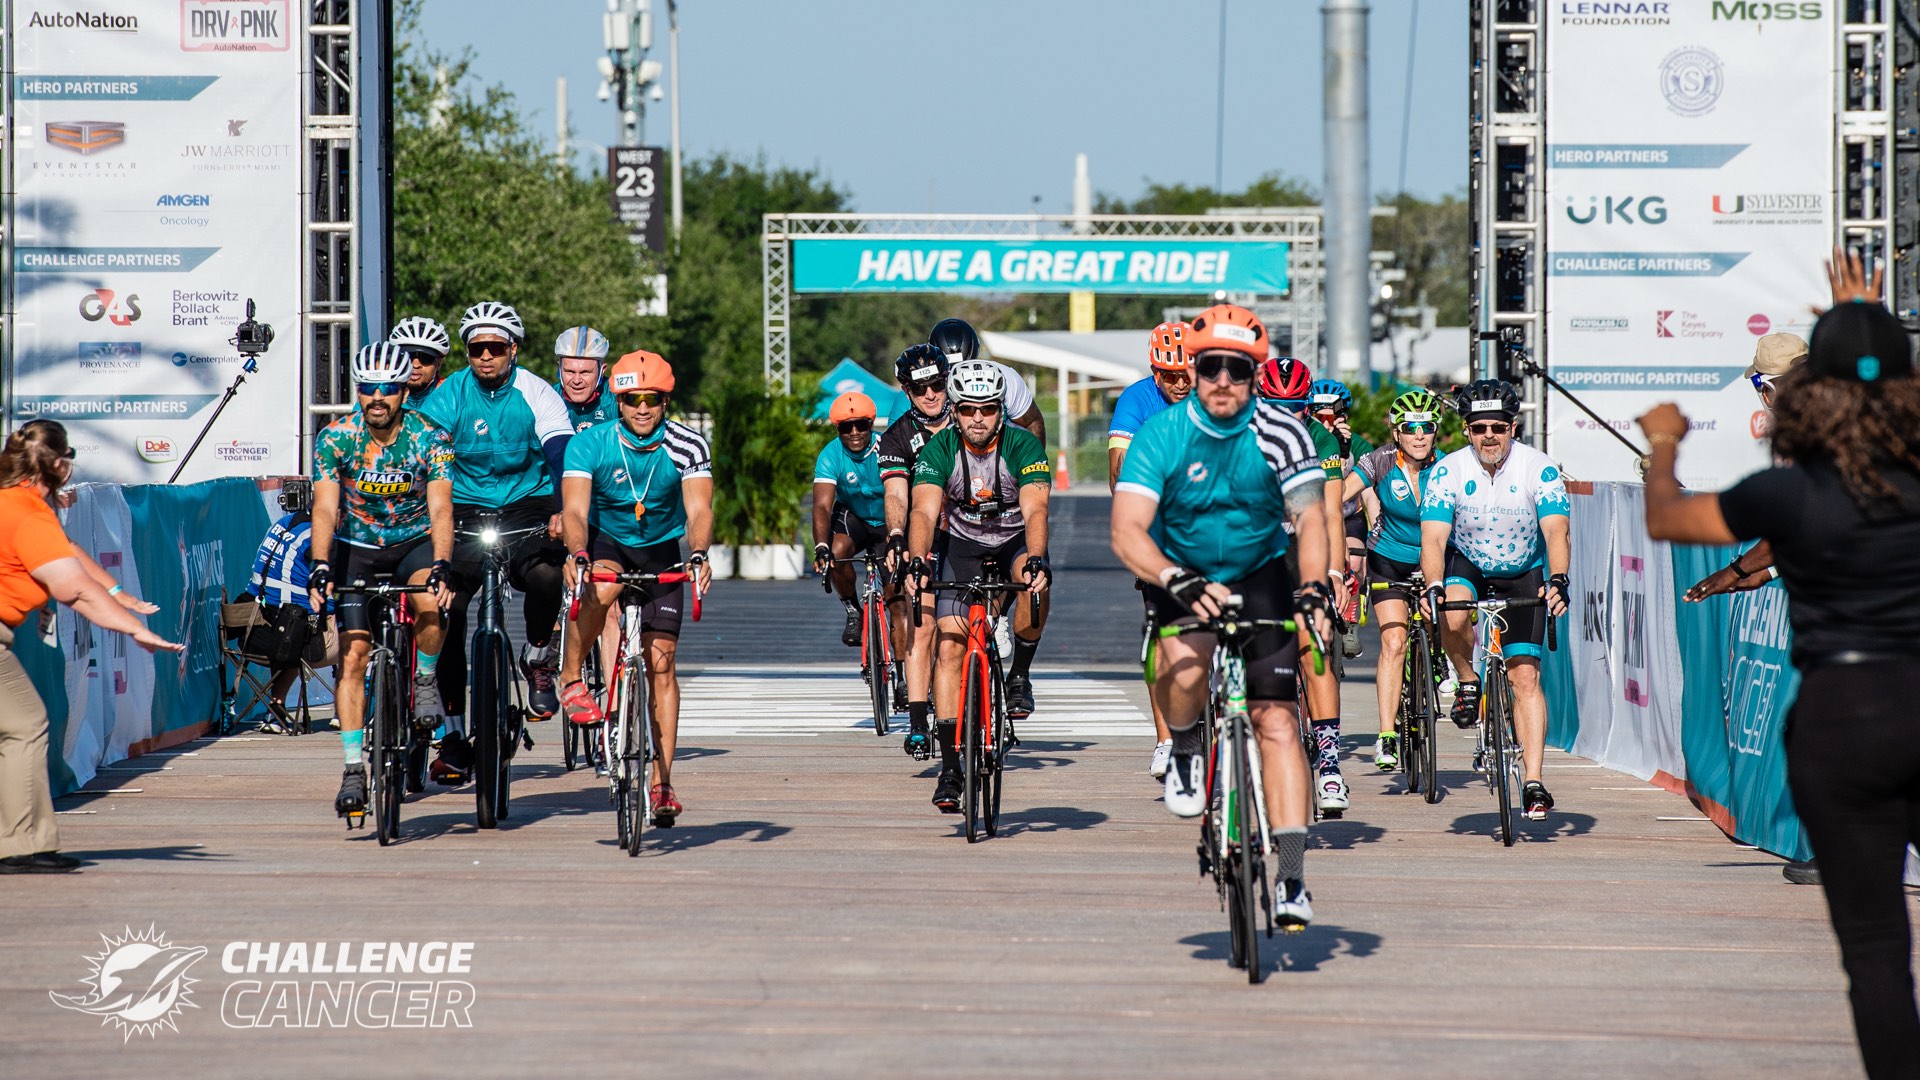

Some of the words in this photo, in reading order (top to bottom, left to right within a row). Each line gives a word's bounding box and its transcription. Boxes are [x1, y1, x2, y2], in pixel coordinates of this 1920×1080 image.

[1562, 2, 1669, 14] LENNAR
[29, 11, 138, 28] AutoNation
[191, 10, 230, 38] DRV
[240, 10, 278, 38] PNK
[1562, 17, 1670, 25] FOUNDATION
[23, 82, 61, 94] HERO
[65, 82, 138, 94] PARTNERS
[181, 145, 207, 157] JW
[210, 145, 291, 157] MARRIOTT
[1555, 150, 1594, 162] HERO
[1596, 150, 1668, 162] PARTNERS
[616, 166, 655, 197] 23
[156, 194, 210, 206] AMGEN
[1746, 194, 1822, 209] SYLVESTER
[160, 216, 209, 226] Oncology
[24, 254, 104, 266] CHALLENGE
[108, 254, 181, 266] PARTNERS
[1556, 258, 1635, 270] CHALLENGE
[1638, 258, 1711, 270] PARTNERS
[858, 249, 961, 282] HAVE
[966, 250, 993, 282] A
[1000, 250, 1124, 283] GREAT
[1127, 251, 1229, 284] RIDE!
[172, 290, 239, 302] Berkowitz
[172, 303, 220, 314] Pollack
[172, 315, 209, 326] Brant
[1681, 320, 1707, 330] Keyes
[1681, 329, 1724, 339] Company
[80, 361, 141, 369] PROVENANCE
[190, 354, 239, 366] Centerplate
[615, 376, 635, 386] 1271
[1556, 372, 1644, 384] SUPPORTING
[1647, 372, 1720, 384] PARTNERS
[971, 384, 989, 392] 1171
[22, 402, 112, 414] SUPPORTING
[115, 402, 188, 414] PARTNERS
[145, 440, 170, 452] Dole
[364, 473, 404, 484] MACK
[1482, 504, 1527, 516] Letendr
